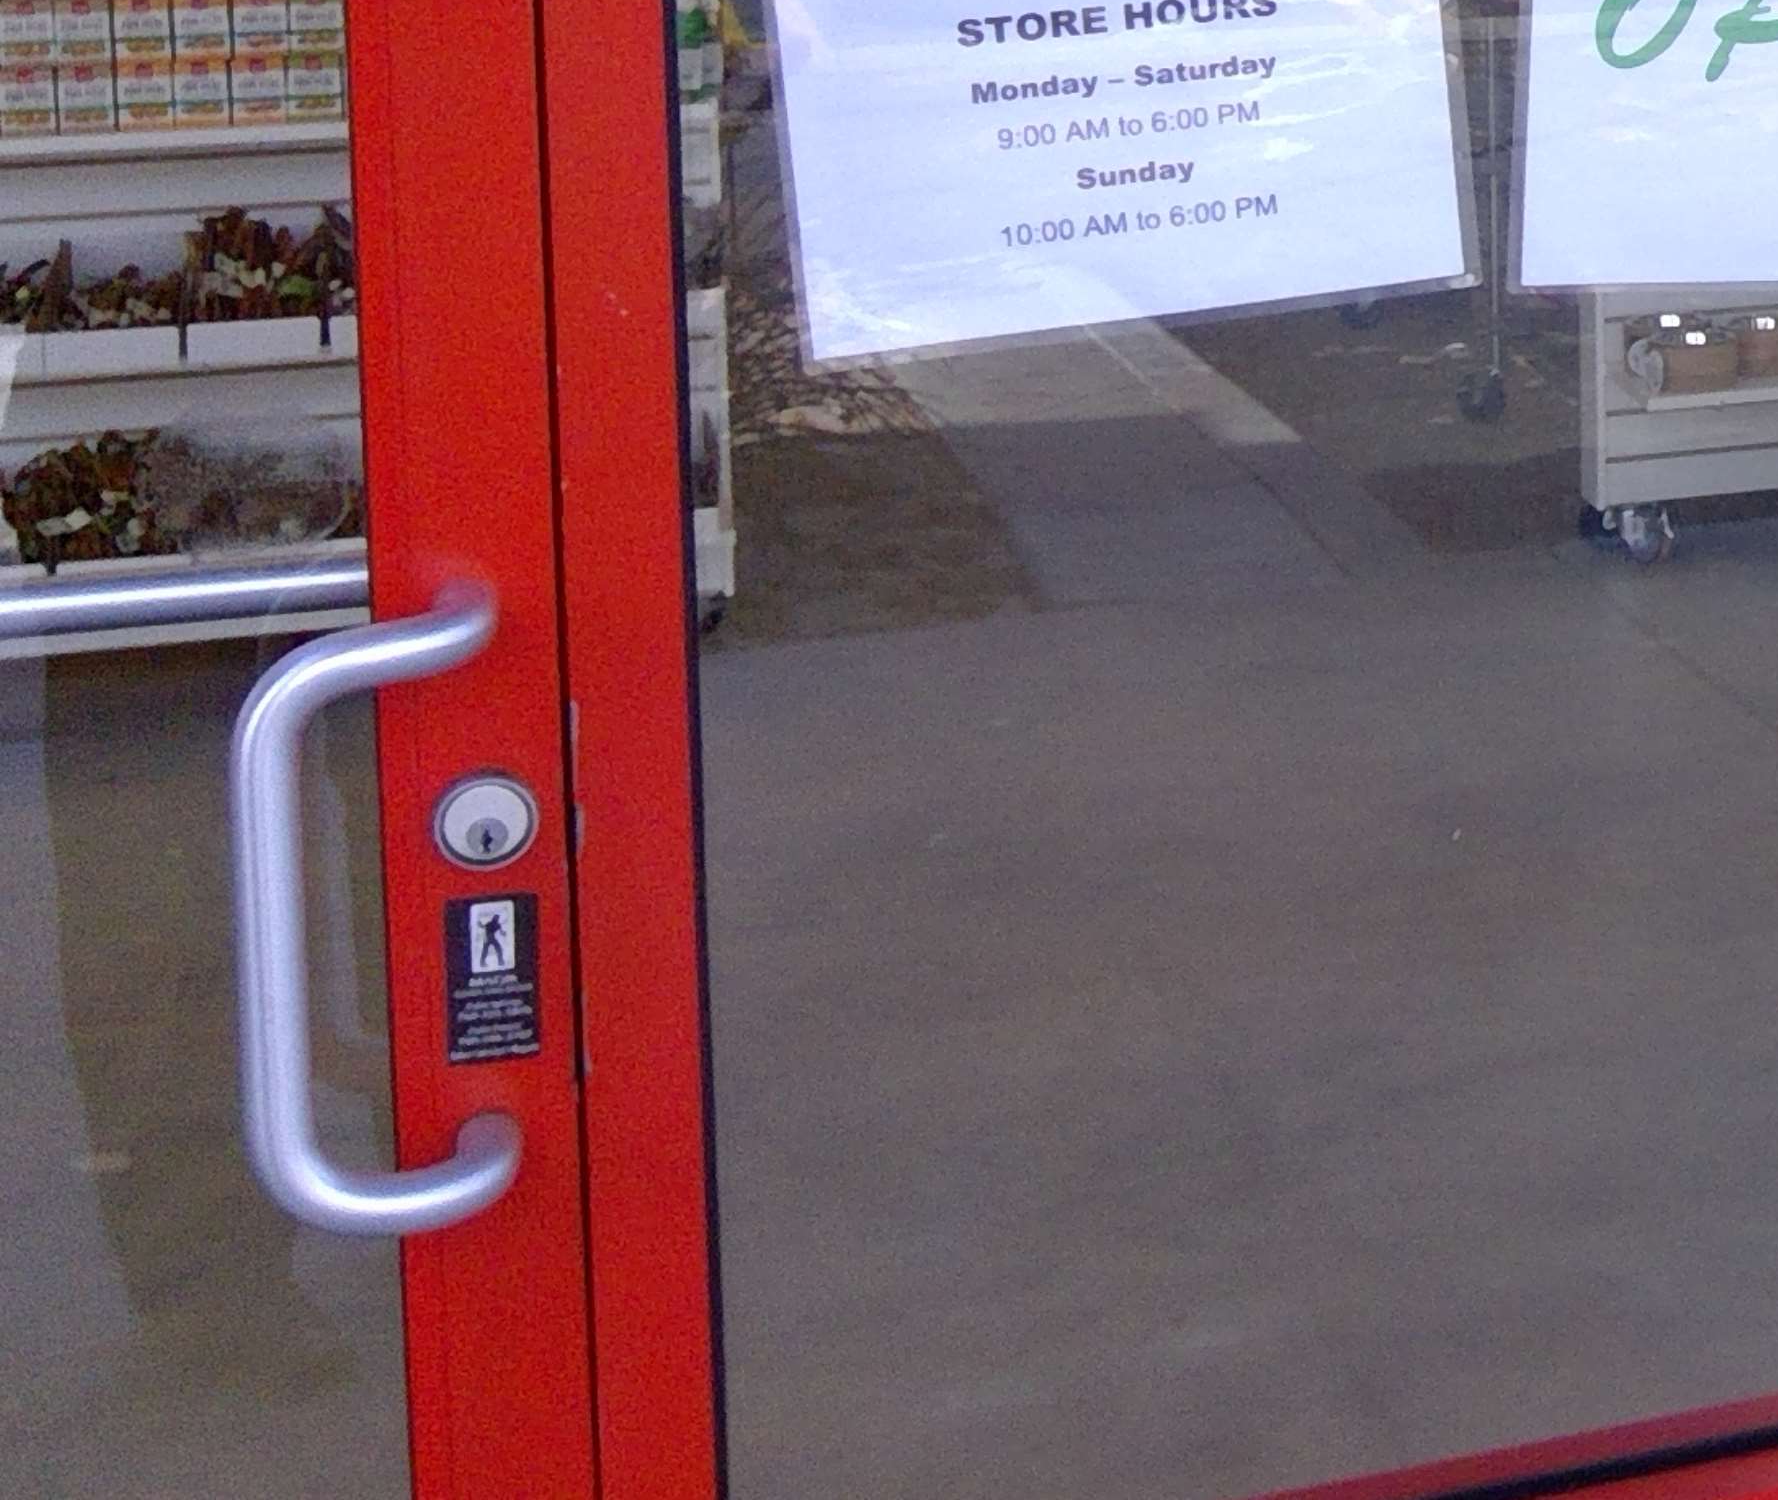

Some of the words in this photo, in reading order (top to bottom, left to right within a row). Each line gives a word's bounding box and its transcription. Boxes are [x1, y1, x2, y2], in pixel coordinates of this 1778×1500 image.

[956, 6, 1109, 47] STORE
[970, 72, 1099, 105] Monday
[1134, 53, 1278, 88] Saturday
[997, 123, 1057, 151] 9:00
[1065, 117, 1110, 145] AM
[1118, 114, 1144, 138] to
[1151, 106, 1210, 134] 6:00
[1218, 99, 1261, 126] PM
[1075, 157, 1196, 190] Sunday
[1000, 218, 1076, 248] 10:00
[1083, 210, 1129, 238] AM
[1136, 207, 1162, 231] to
[1168, 199, 1227, 228] 6:00
[1235, 192, 1279, 219] PM
